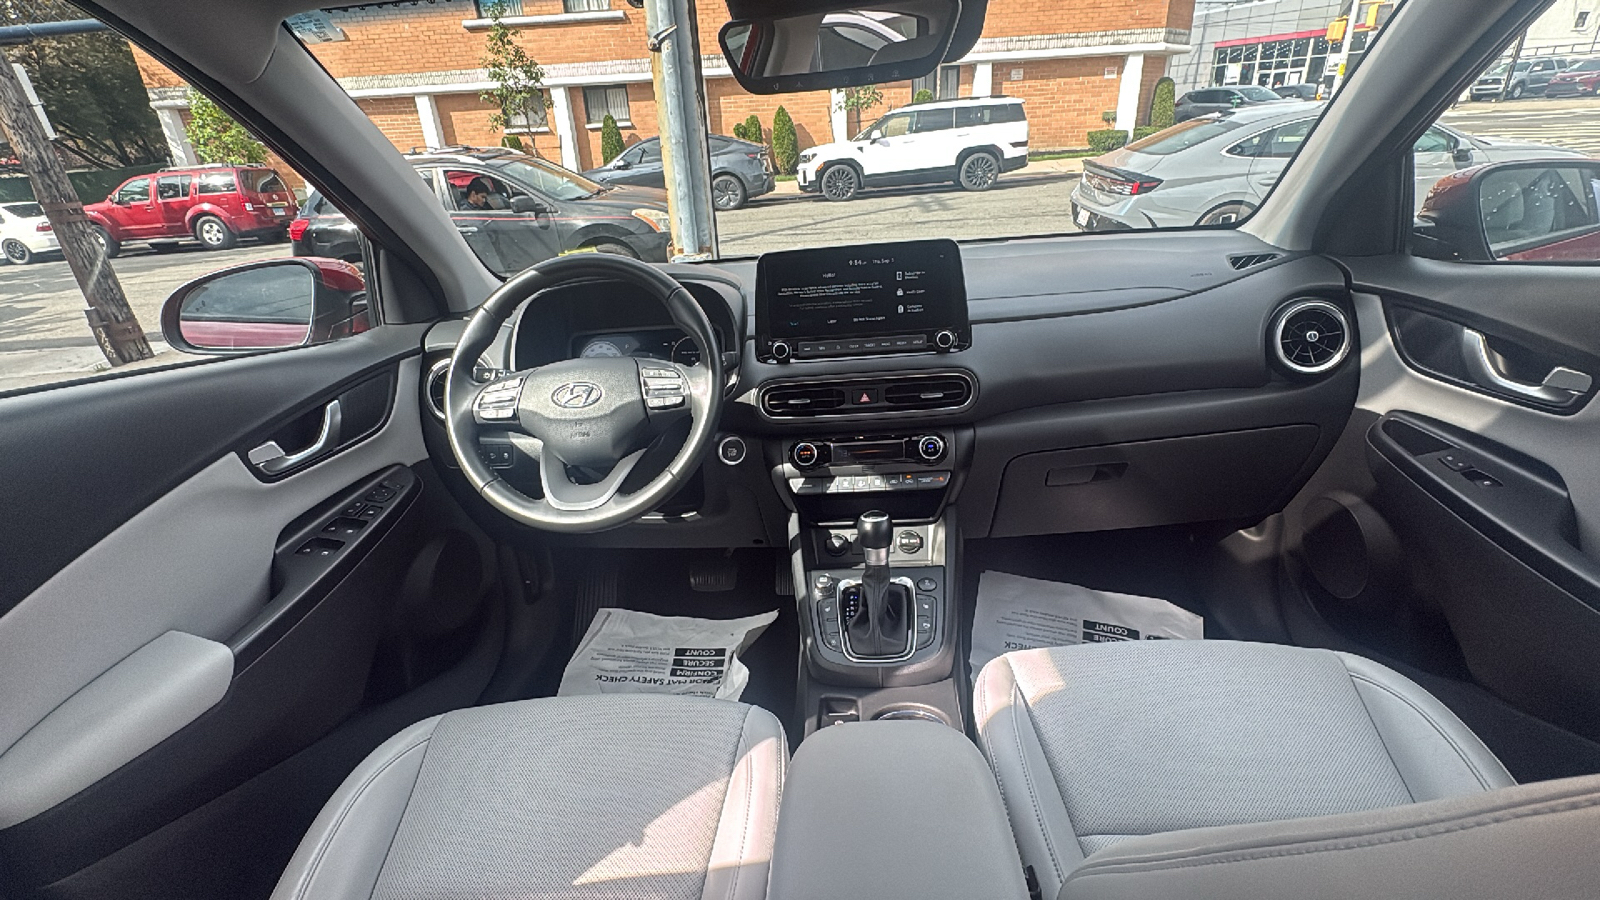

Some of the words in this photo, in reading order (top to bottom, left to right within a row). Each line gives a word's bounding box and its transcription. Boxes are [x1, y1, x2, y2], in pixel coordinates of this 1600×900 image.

[1095, 623, 1128, 635] COUNT
[1004, 641, 1037, 649] HECK
[682, 659, 716, 667] SECURE
[676, 669, 718, 677] CONFIRM
[594, 674, 628, 684] CHECK
[628, 675, 665, 686] SAFETY
